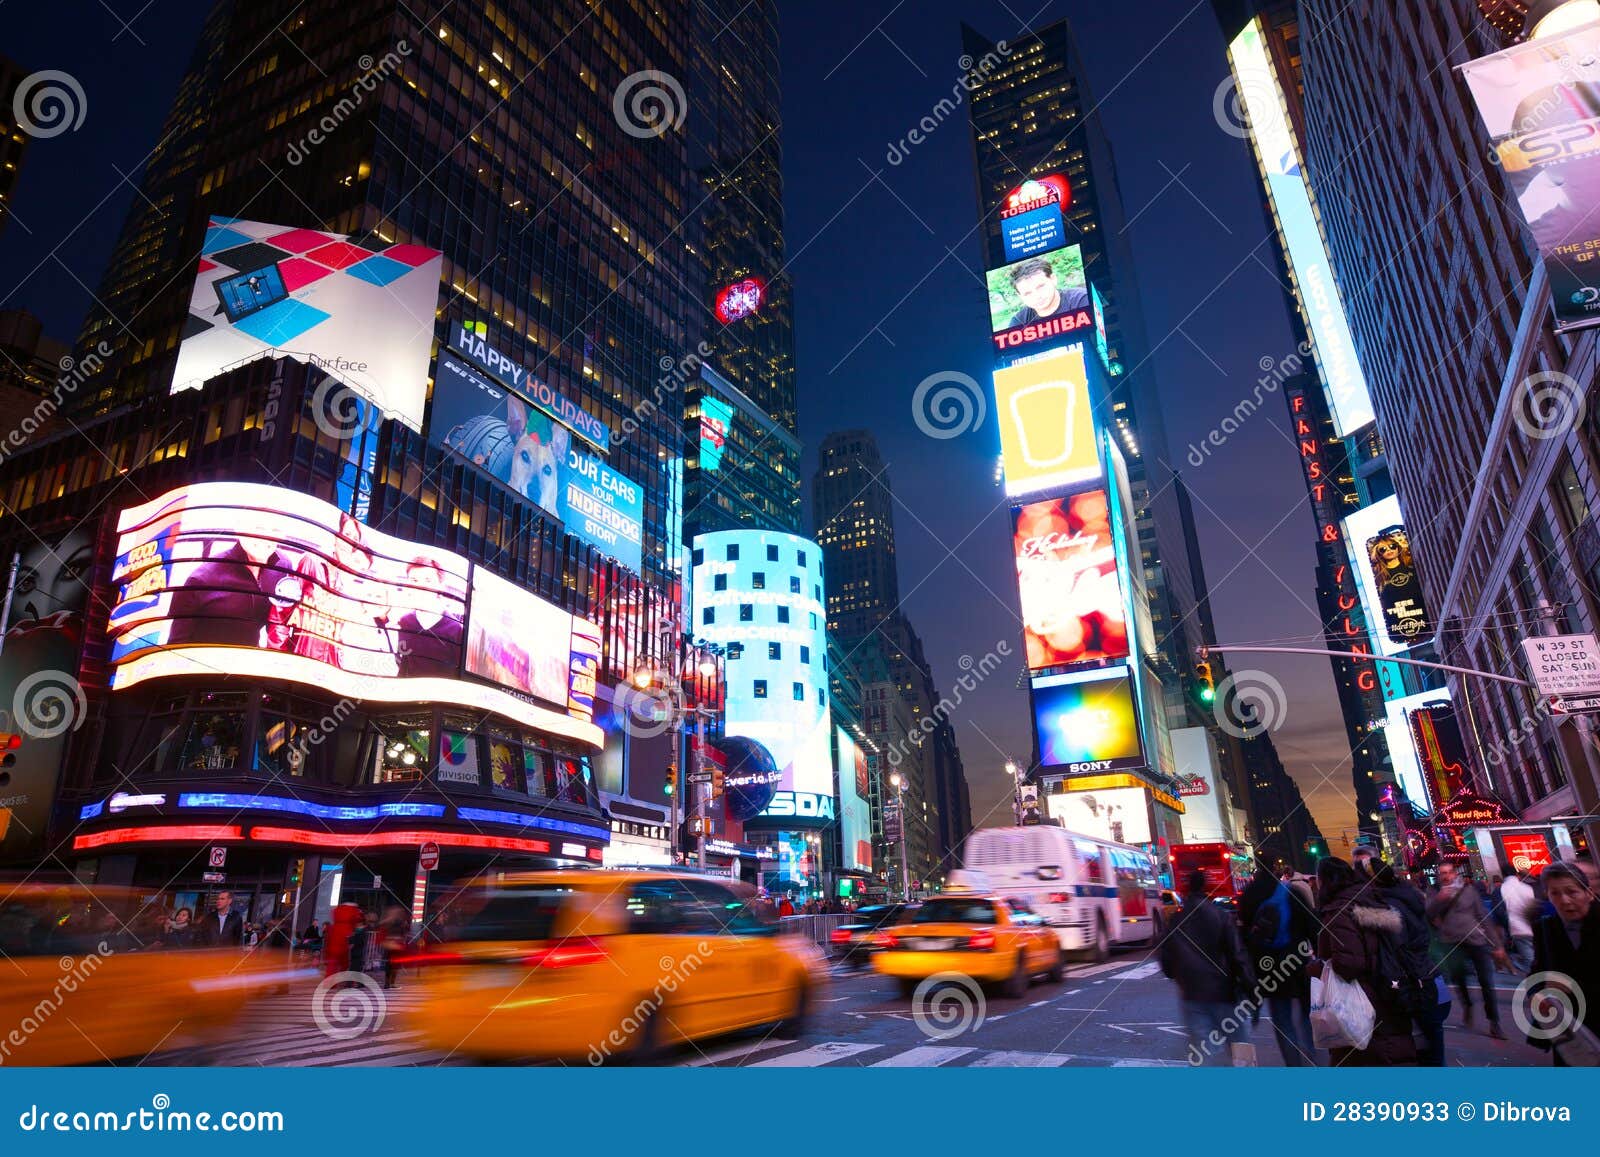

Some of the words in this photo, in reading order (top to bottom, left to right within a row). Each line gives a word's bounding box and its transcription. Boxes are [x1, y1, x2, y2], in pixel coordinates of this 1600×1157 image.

[1001, 194, 1058, 219] TOSHIBA
[1556, 243, 1581, 255] THE
[1577, 251, 1595, 262] OF
[994, 311, 1092, 350] TOSHIBA
[309, 355, 368, 373] Surface
[443, 360, 503, 400] NITTO
[459, 328, 523, 386] HAPPY
[525, 373, 603, 441] HOLIDAYS
[260, 360, 285, 442] 1500
[591, 483, 615, 505] YOUR
[601, 469, 636, 505] EARS
[585, 519, 618, 546] STORY
[1322, 524, 1339, 542] &
[1022, 530, 1099, 557] Holiday
[1536, 643, 1545, 652] W
[1551, 641, 1566, 651] 39
[1571, 640, 1585, 649] ST
[1541, 651, 1588, 662] CLOSED
[1541, 664, 1564, 674] SAT
[1571, 662, 1597, 672] SUN
[1558, 701, 1577, 710] ONE
[1069, 760, 1113, 774] SONY
[758, 791, 834, 820] SDA
[1452, 811, 1473, 820] Hard
[1473, 809, 1493, 820] Rock
